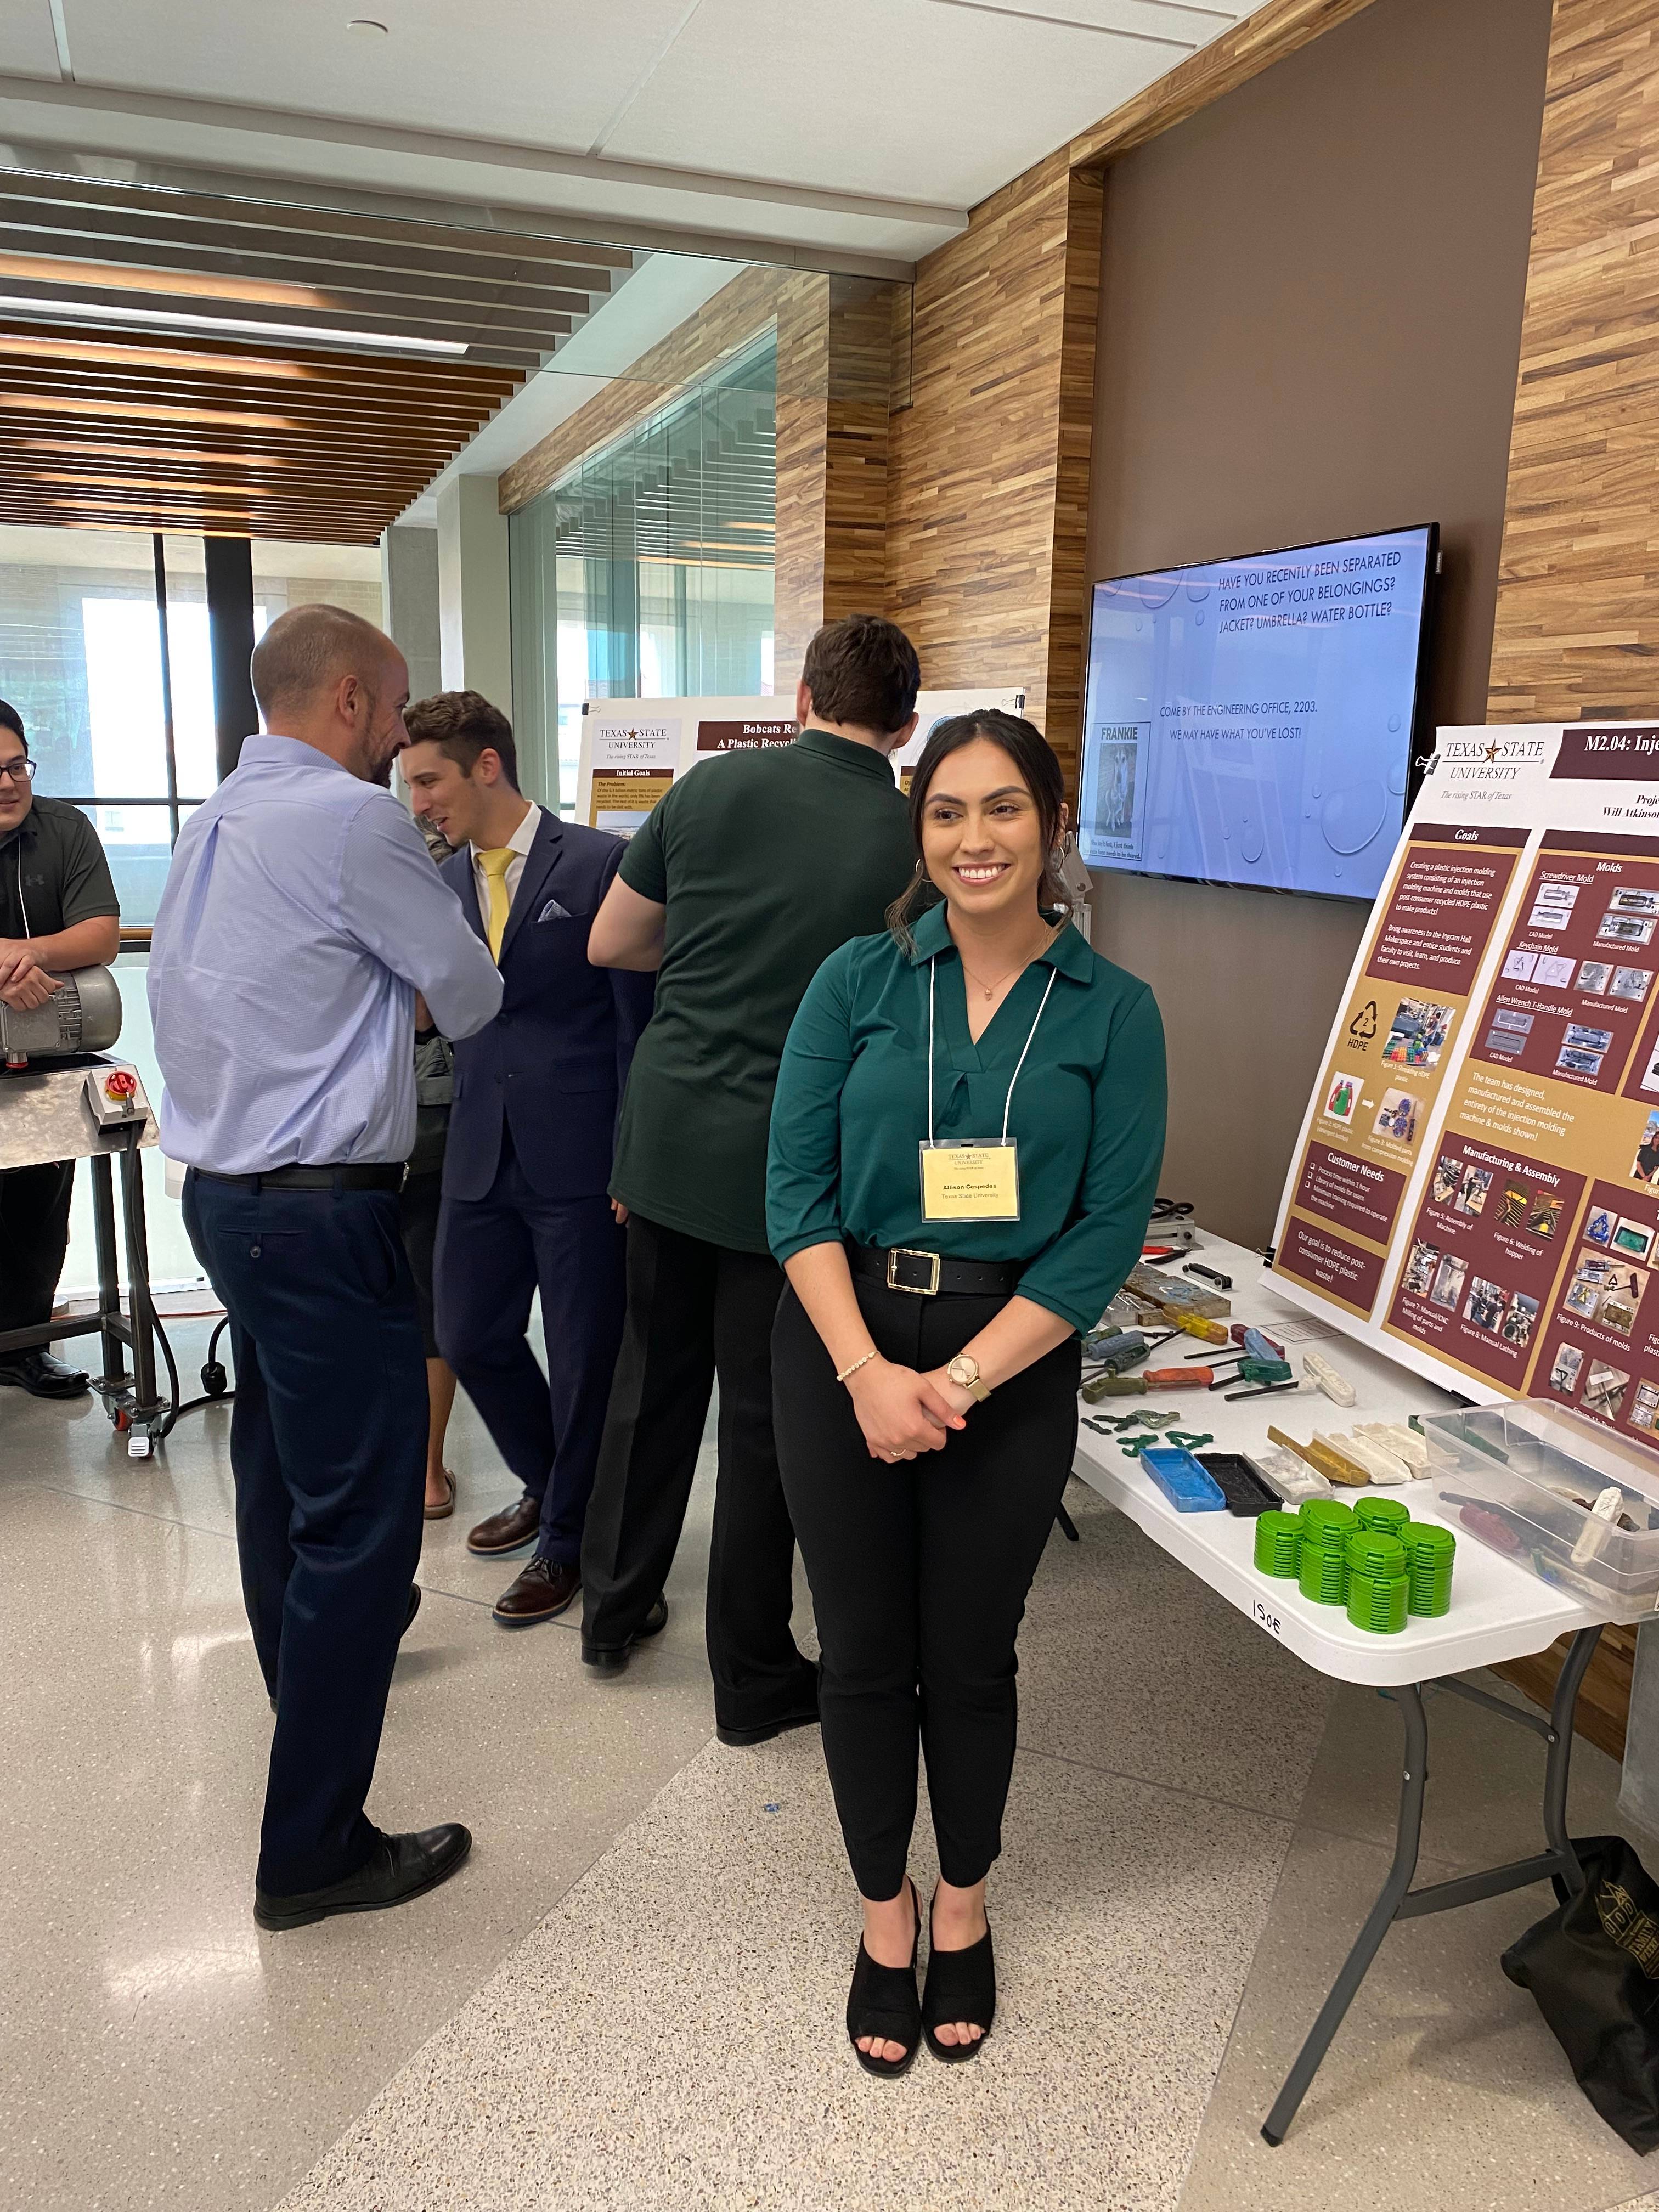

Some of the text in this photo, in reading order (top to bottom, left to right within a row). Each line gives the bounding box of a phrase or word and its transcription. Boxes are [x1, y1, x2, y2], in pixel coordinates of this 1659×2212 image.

[1219, 551, 1401, 590] HAVE YOU RECENTLY BEEN SEPARATED
[1220, 577, 1395, 612] FROM ONE OF YOUR BELONGINGS?
[1220, 602, 1392, 633] JACKET? UMBRELLA? WATER BOTTLE?
[1160, 701, 1317, 717] COME BY THE ENGINEERING OFFICE, 2203.
[743, 724, 781, 733] Bobcats
[1101, 727, 1138, 740] FRANKIE
[1170, 727, 1301, 740] WE MAY HAVE WHAT YOU'VE LOST!
[717, 740, 725, 748] A
[727, 739, 758, 748] Plastic
[1447, 742, 1545, 757] TEXAS STATE
[1584, 735, 1631, 751] M2.04:
[1451, 768, 1521, 779] UNIVERSITY
[1452, 791, 1469, 800] rising
[1488, 792, 1495, 801] of
[1603, 807, 1622, 816] Will
[1455, 830, 1479, 841] Goals
[1410, 862, 1430, 871] Creating
[1450, 865, 1472, 873] injection
[1473, 867, 1496, 877] molding
[1596, 862, 1623, 873] Molds
[1424, 874, 1446, 883] consisting
[1461, 877, 1484, 886] injection
[1541, 871, 1594, 883] Screwdriver Mold
[1403, 883, 1422, 892] molding
[1453, 888, 1470, 896] molds
[1398, 894, 1488, 910] post-consumer recycled HDPE plastic
[1414, 906, 1438, 915] products!
[1519, 941, 1559, 953] Keychain Mold
[1593, 941, 1640, 952] Manufactured Mold
[1497, 995, 1573, 1015] Allen Wrench T-Handle Mold
[1363, 1018, 1368, 1026] 2
[1347, 1038, 1368, 1051] HDPE
[1473, 1072, 1545, 1101] The team has designed,
[1468, 1086, 1575, 1122] manufactured and assembled the
[1464, 1099, 1566, 1137] entirety of the injection molding
[1459, 1111, 1538, 1141] machine & molds shown!
[1328, 1152, 1385, 1182] Customer Needs
[1463, 1145, 1560, 1187] Manufacturing & Assembly
[1298, 1231, 1366, 1269] Our goal is to reduce post-
[1493, 1232, 1509, 1243] Figure
[1515, 1240, 1536, 1255] Welding
[1505, 1248, 1525, 1260] hopper
[1299, 1246, 1358, 1281] consumer HDPE plastic
[1315, 1269, 1334, 1283] waste!
[1556, 1313, 1574, 1325] Figure
[1580, 1324, 1605, 1340] Products
[1612, 1339, 1631, 1352] molds
[1460, 1324, 1475, 1335] Figure
[1480, 1334, 1500, 1347] Manual
[1499, 1342, 1519, 1358] Lathing
[1628, 1921, 1656, 1955] FAMILY
